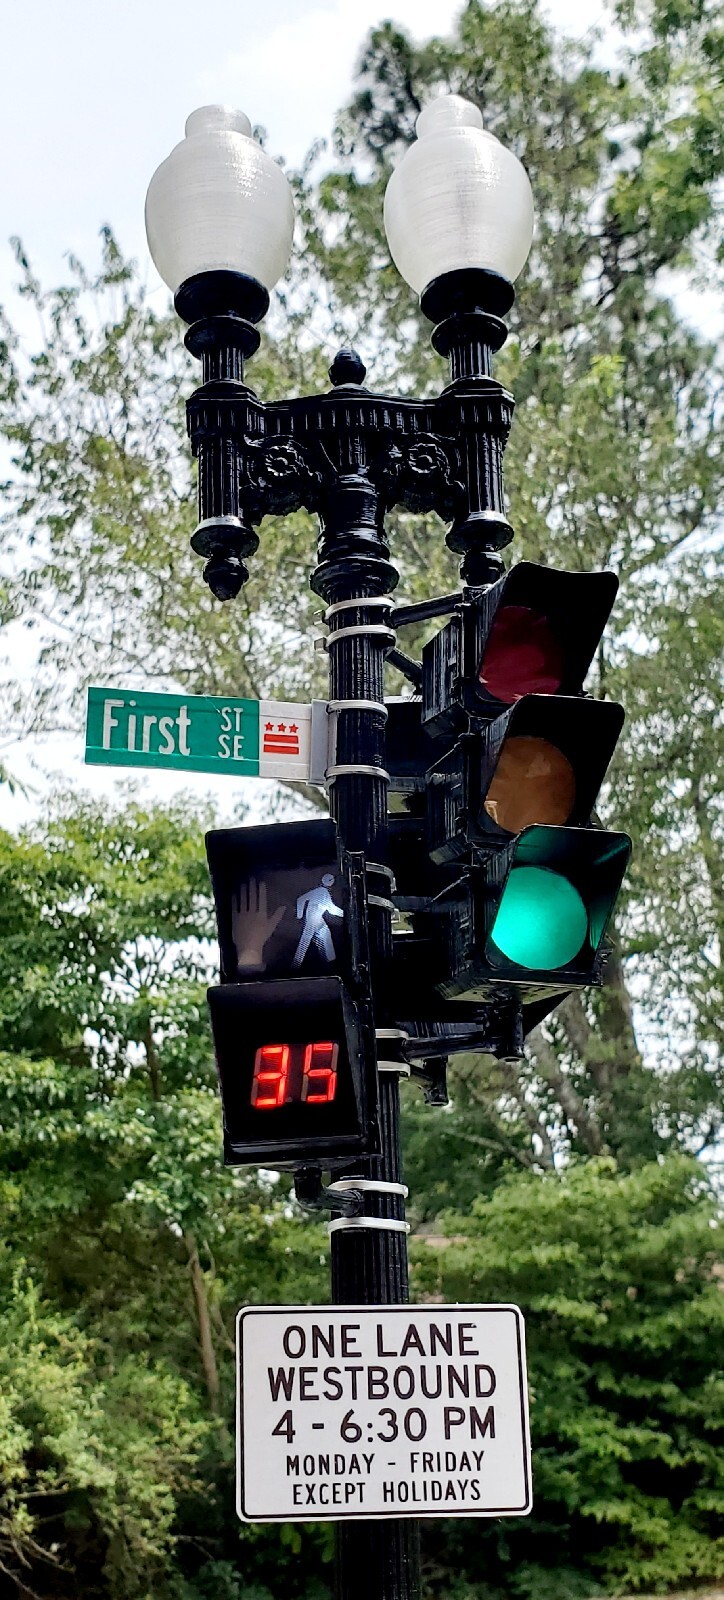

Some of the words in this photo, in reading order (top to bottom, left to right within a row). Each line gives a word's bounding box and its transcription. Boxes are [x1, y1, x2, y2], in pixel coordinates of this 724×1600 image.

[103, 699, 191, 756] First
[221, 706, 244, 732] ST
[218, 734, 245, 759] SE
[253, 1043, 338, 1107] 35
[283, 1324, 362, 1358] ONE
[377, 1323, 479, 1357] LANE
[268, 1364, 496, 1401] WESTBOUND
[271, 1410, 296, 1443] 4
[340, 1407, 427, 1443] 6:30
[444, 1406, 496, 1440] PM
[286, 1453, 375, 1476] MONDAY
[410, 1450, 485, 1473] FRIDAY
[293, 1482, 366, 1505] EXCEPT
[383, 1479, 481, 1503] HOLIDAYS
